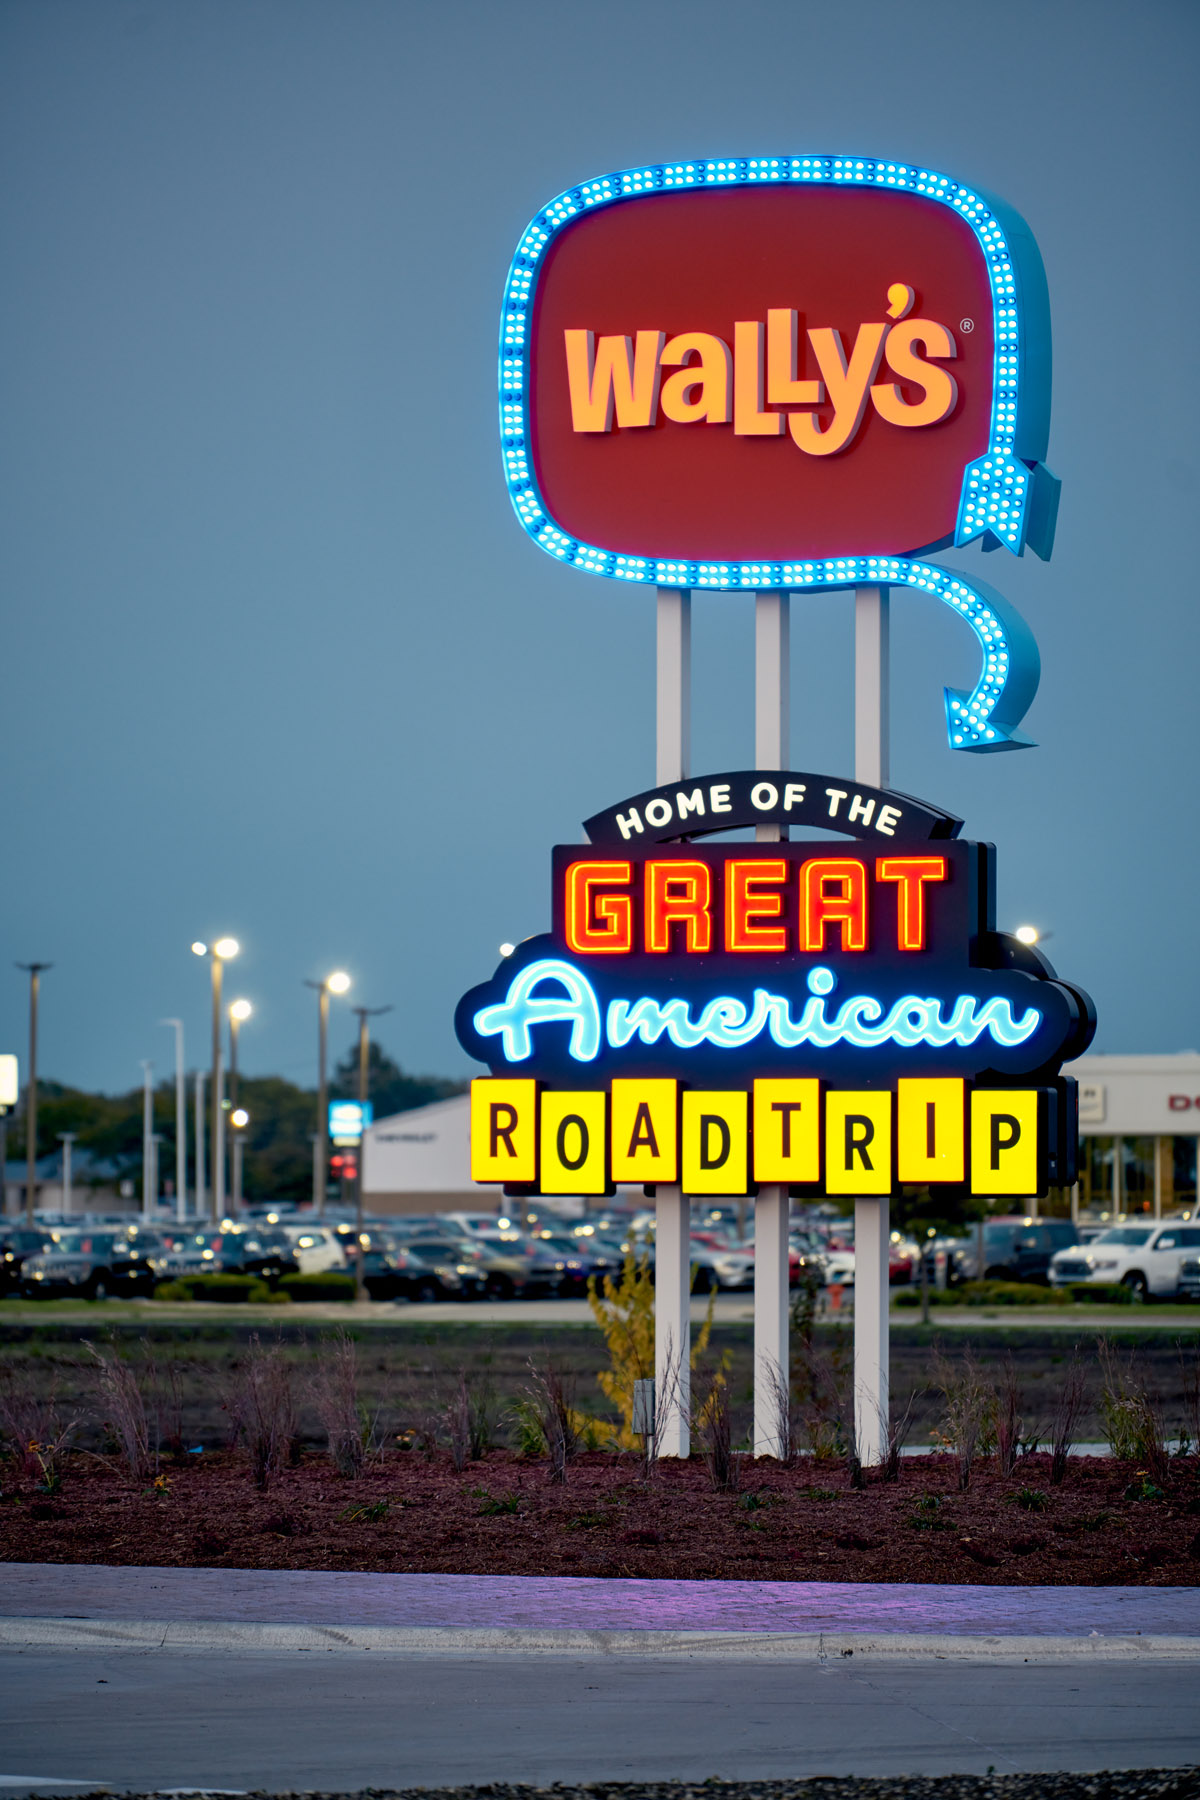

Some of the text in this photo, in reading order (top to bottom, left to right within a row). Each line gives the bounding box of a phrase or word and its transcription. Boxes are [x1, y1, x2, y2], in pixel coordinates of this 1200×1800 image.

[615, 782, 902, 840] HOME OF THE
[565, 857, 948, 954] GREAT
[474, 959, 1043, 1063] American
